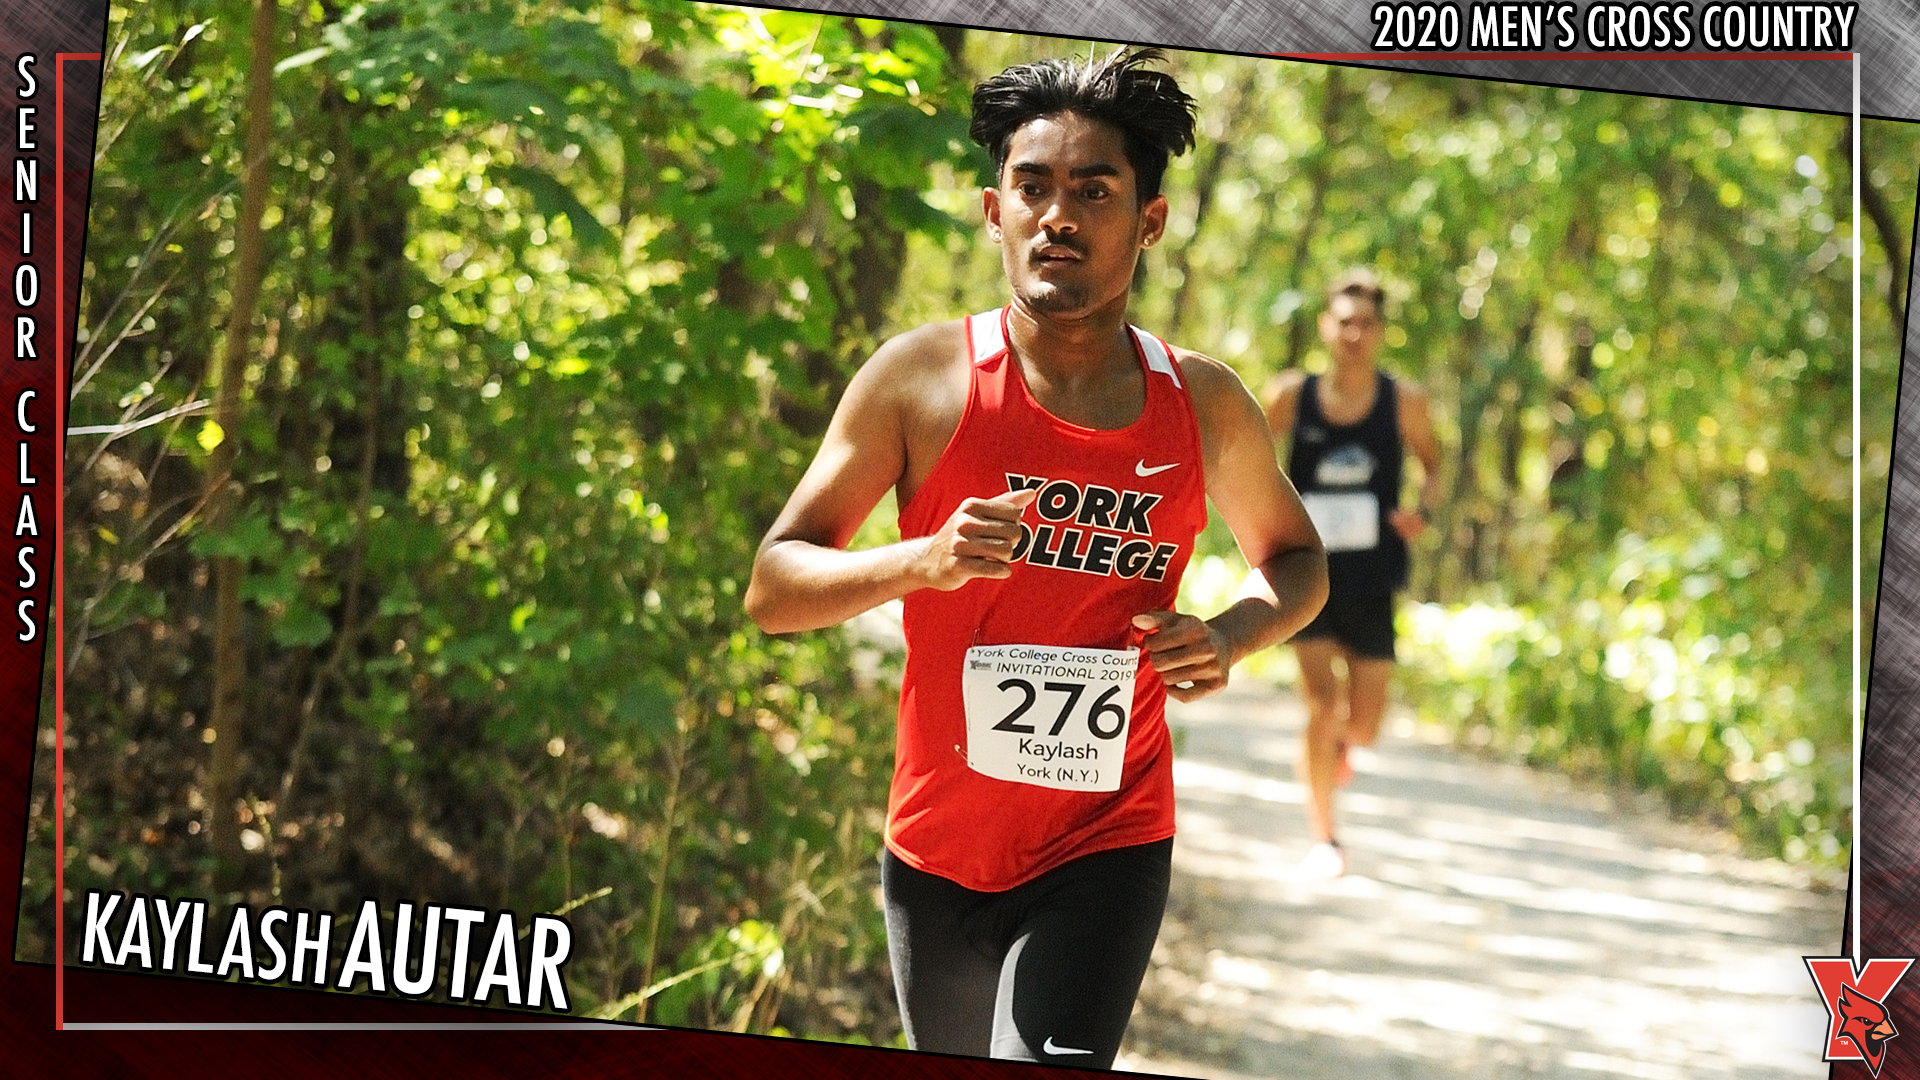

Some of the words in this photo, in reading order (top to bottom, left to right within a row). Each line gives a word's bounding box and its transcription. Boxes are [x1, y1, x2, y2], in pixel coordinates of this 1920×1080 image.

[1005, 473, 1163, 536] YORK
[1009, 522, 1179, 582] OLLEGE
[977, 648, 1004, 658] York
[1009, 648, 1057, 663] College
[1062, 651, 1097, 664] Cross
[996, 662, 1095, 680] INVITATIONAL
[991, 678, 1126, 740] 276
[1019, 738, 1098, 761] Kaylash
[1017, 763, 1051, 780] York
[1057, 767, 1099, 783] (N.Y.)
